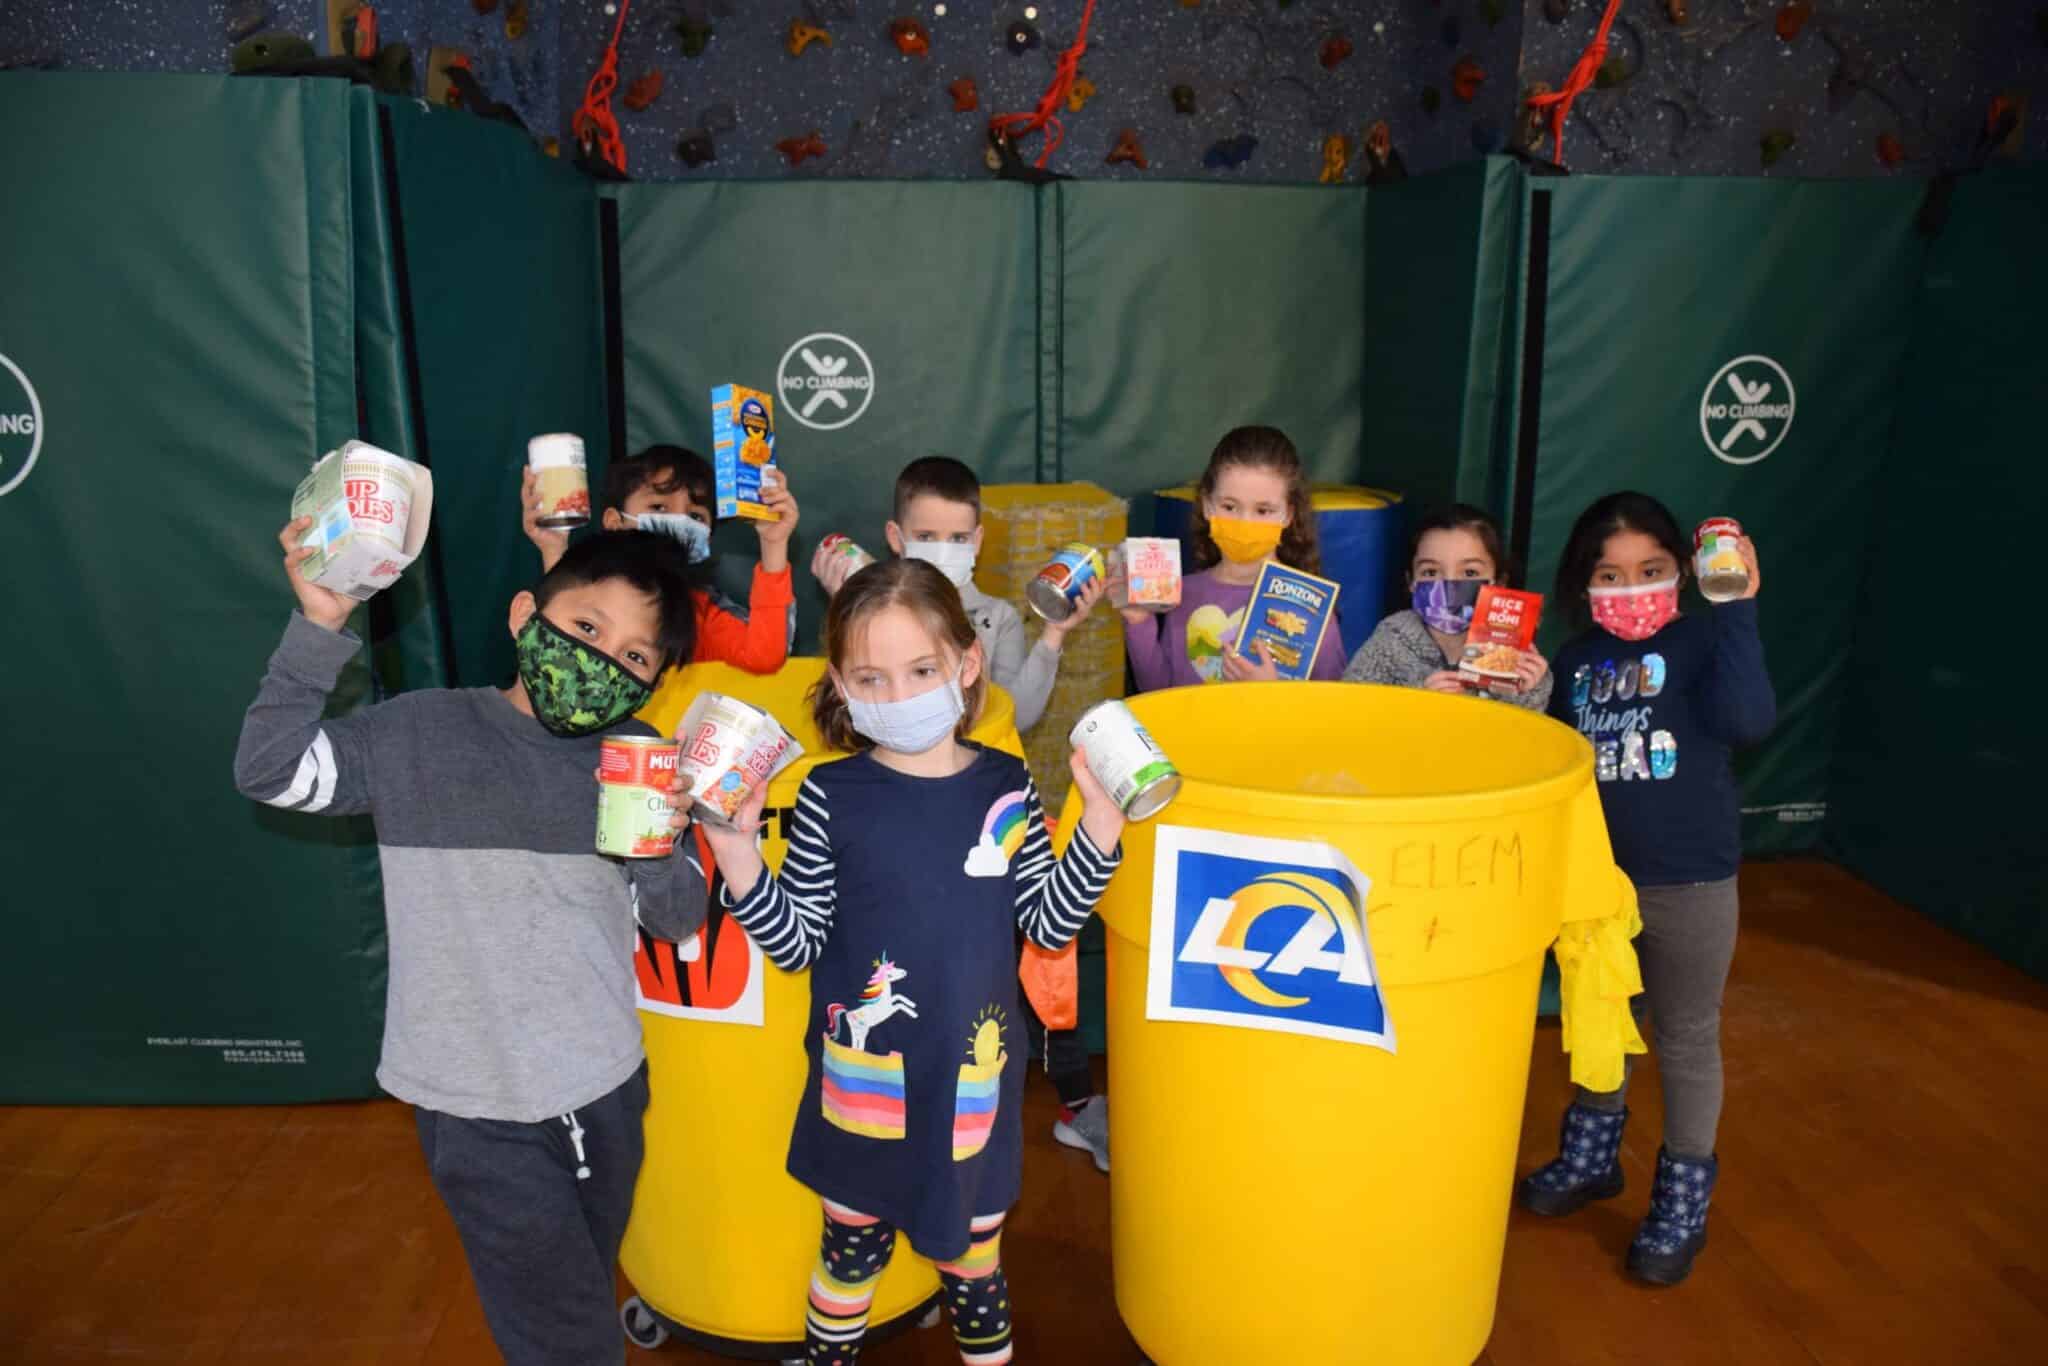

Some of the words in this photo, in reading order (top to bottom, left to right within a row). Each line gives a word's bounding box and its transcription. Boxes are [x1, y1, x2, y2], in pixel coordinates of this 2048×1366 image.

[783, 376, 804, 389] NO
[806, 376, 870, 390] CLIMBING
[1706, 404, 1727, 418] NO
[1728, 404, 1790, 418] CLIMBING
[1490, 596, 1525, 612] RICE
[1572, 652, 1667, 706] GOOD
[1574, 703, 1653, 744] Things
[1590, 729, 1678, 781] EAD
[1390, 831, 1524, 896] ELEM
